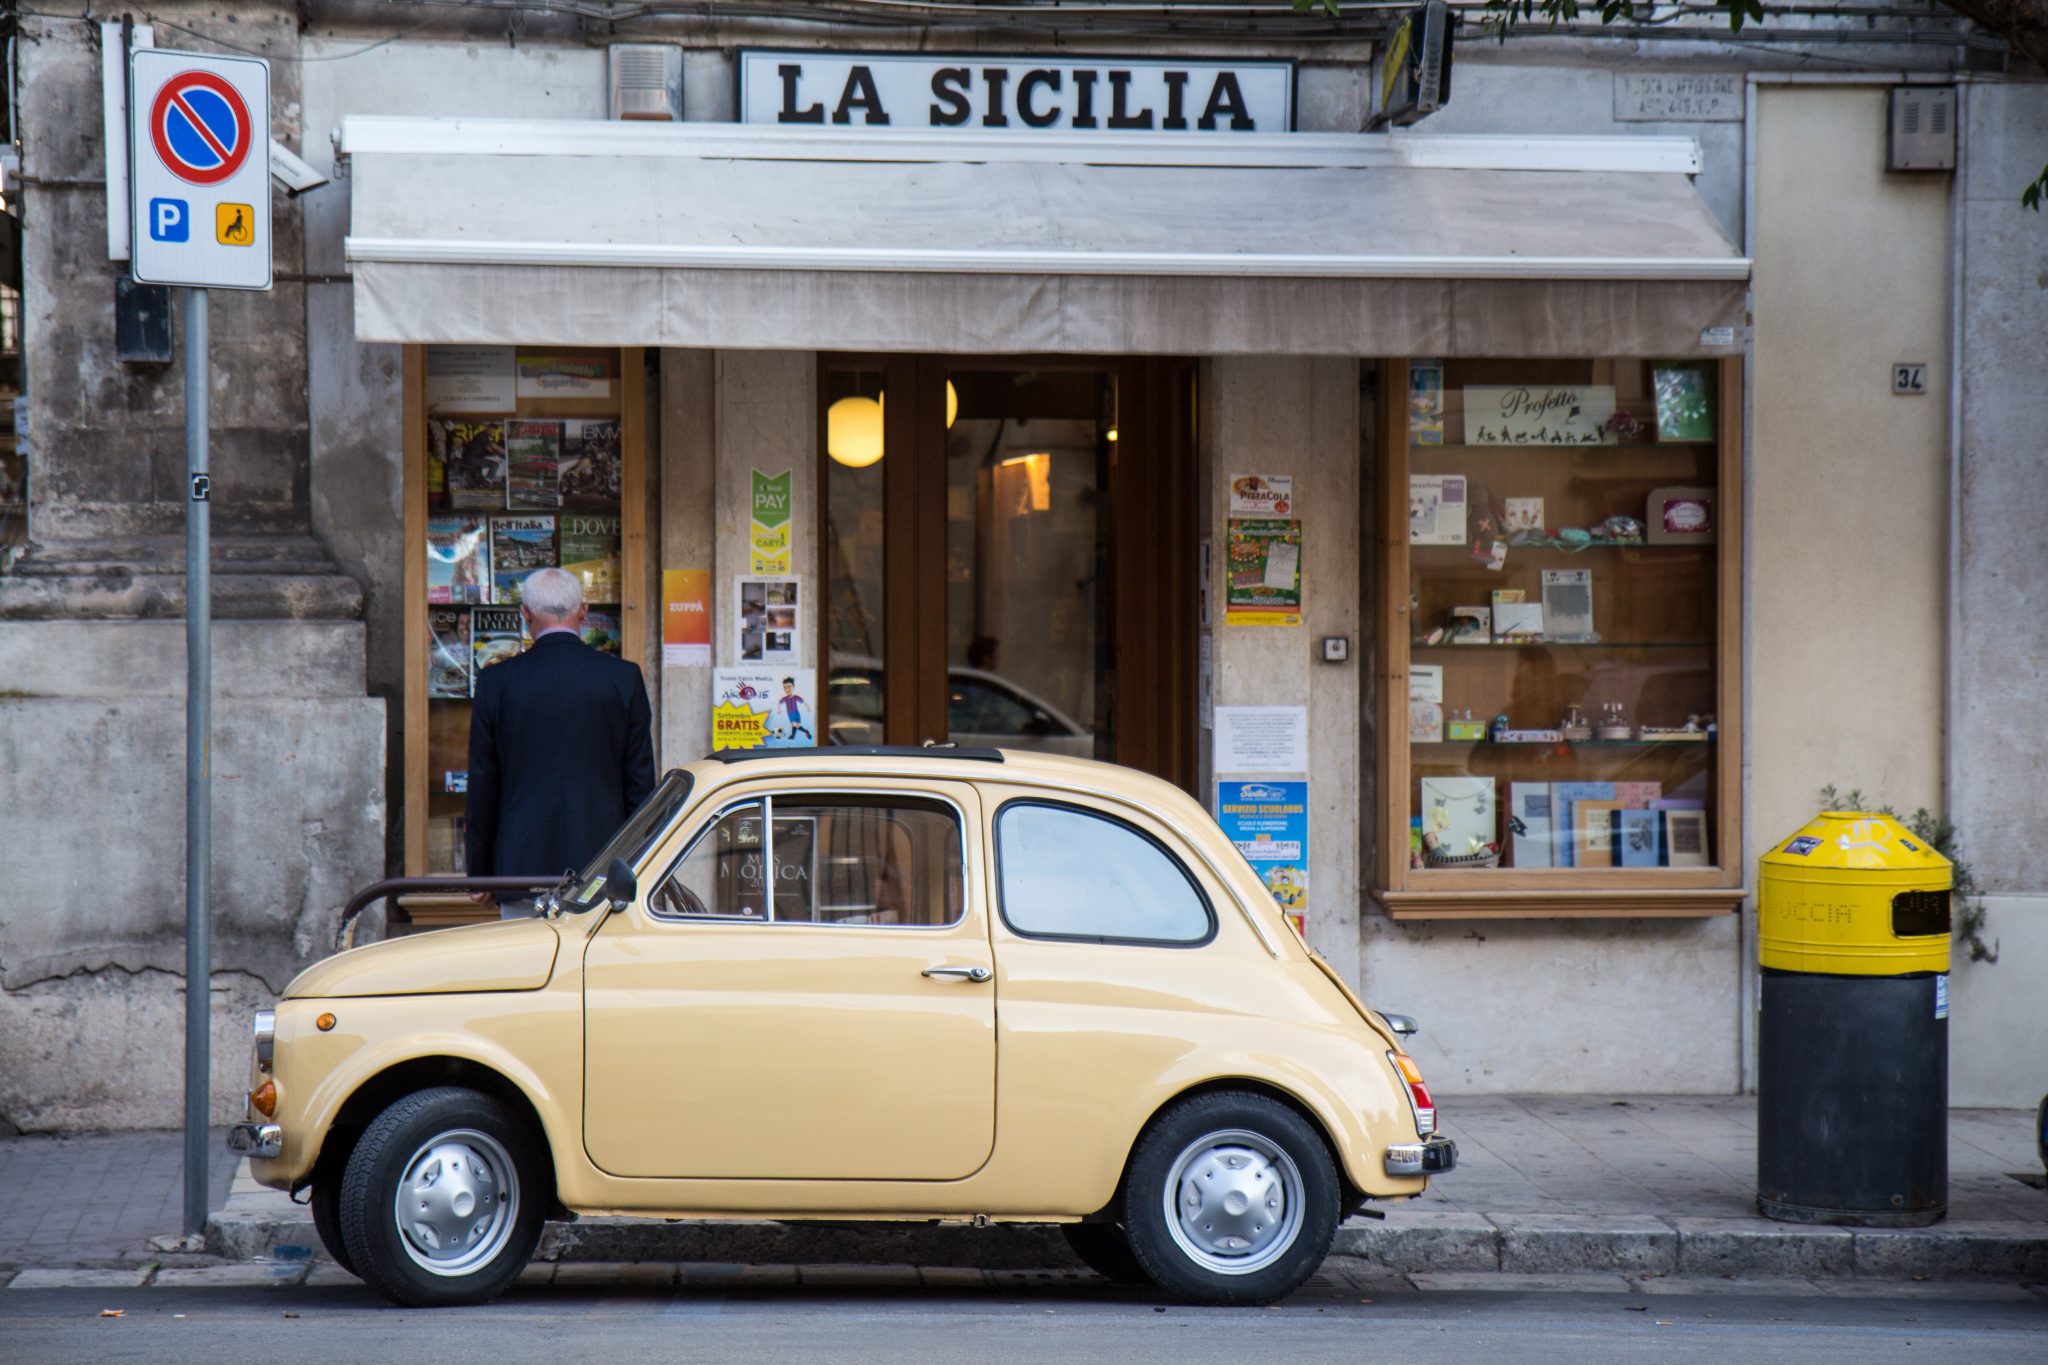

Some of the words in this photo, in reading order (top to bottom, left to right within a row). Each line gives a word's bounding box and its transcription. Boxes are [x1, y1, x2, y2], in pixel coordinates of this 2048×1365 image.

[778, 64, 890, 125] LA
[929, 67, 1255, 131] SICILIA
[157, 203, 181, 237] P
[755, 494, 786, 509] PAY
[717, 720, 760, 731] GRATIS
[1222, 804, 1257, 814] SERVIZIO
